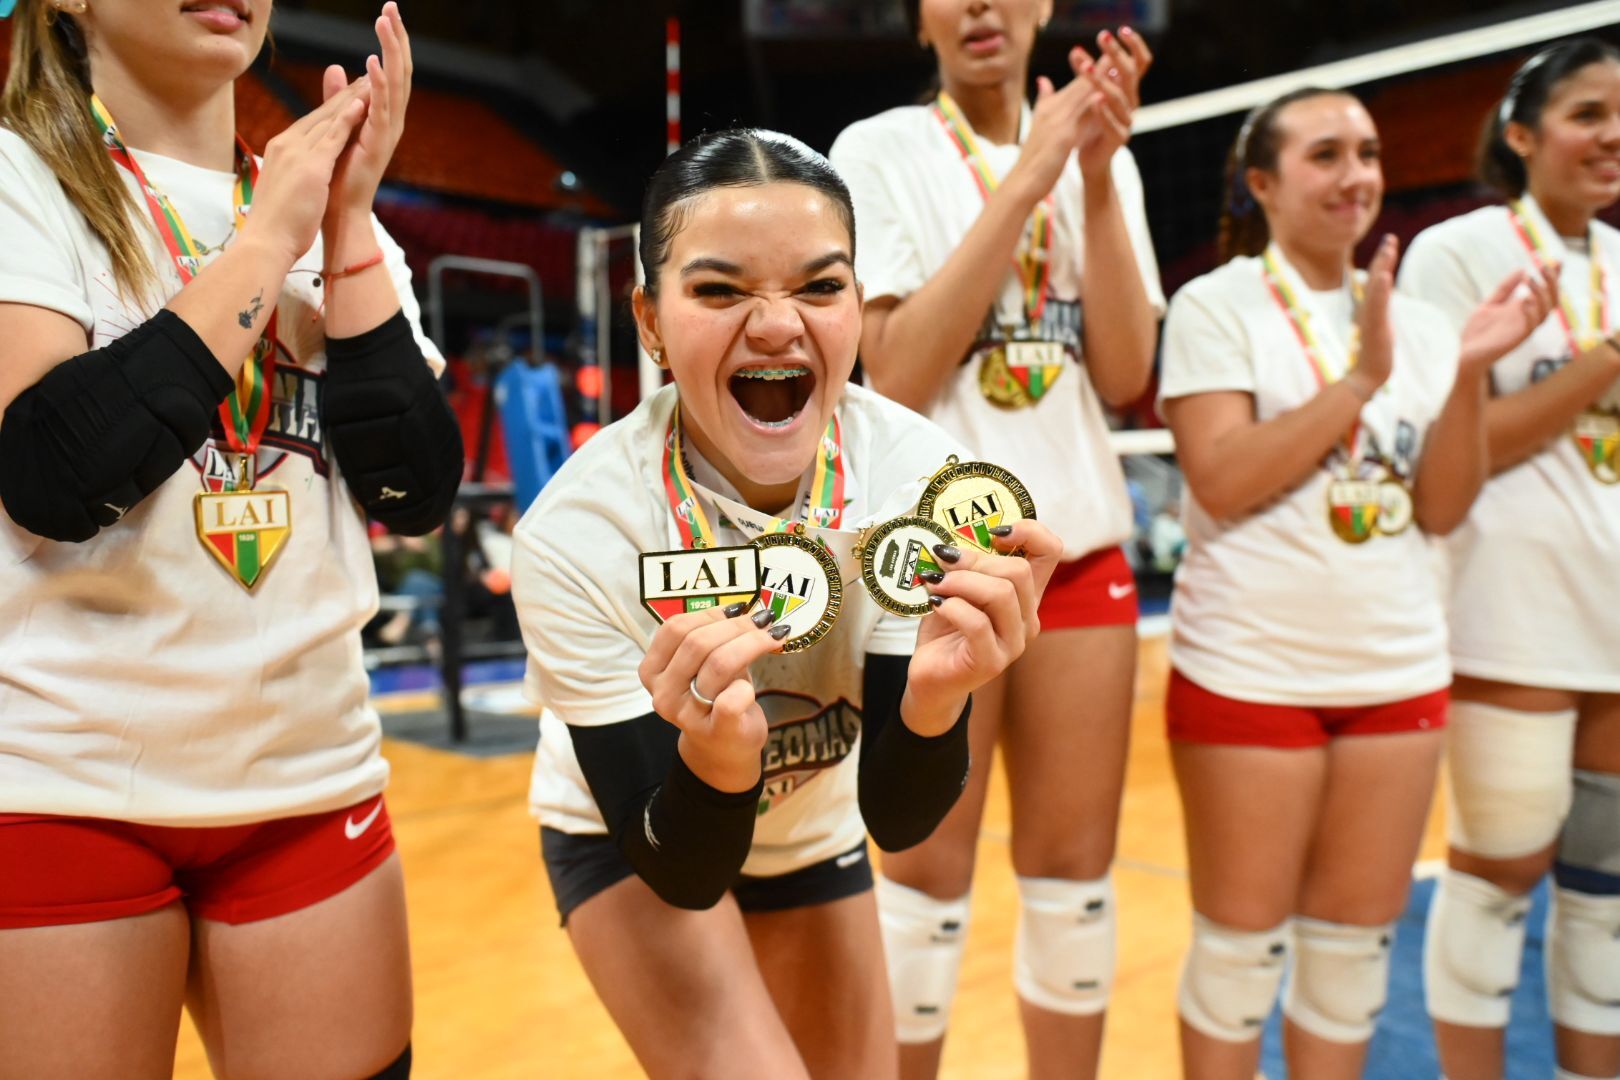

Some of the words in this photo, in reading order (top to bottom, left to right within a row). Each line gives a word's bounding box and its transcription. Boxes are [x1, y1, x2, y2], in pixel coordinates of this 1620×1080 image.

[215, 499, 275, 527] LAI
[947, 494, 999, 527] LAI
[660, 556, 739, 592] LAI
[761, 566, 812, 597] LAI
[903, 545, 920, 585] LAI
